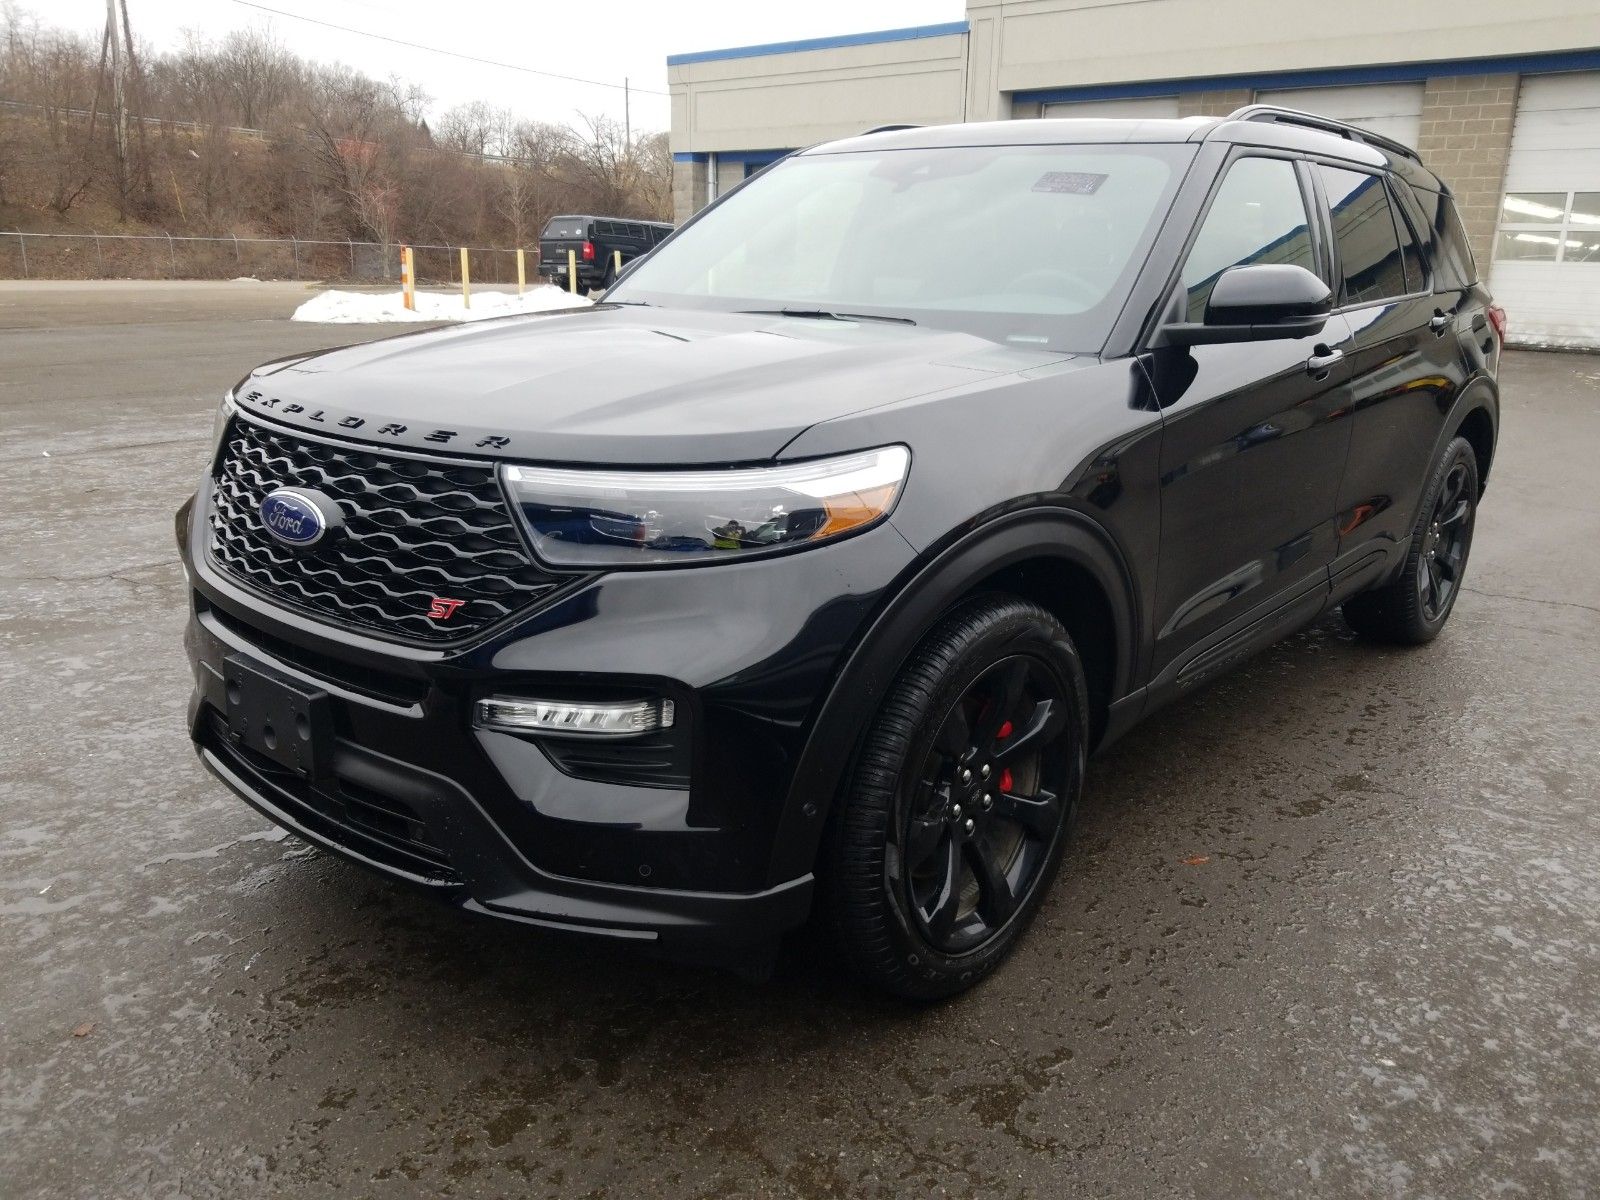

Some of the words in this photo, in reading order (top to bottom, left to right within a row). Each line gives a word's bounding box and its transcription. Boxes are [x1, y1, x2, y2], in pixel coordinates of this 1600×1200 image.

[244, 390, 512, 450] EXPLORER
[268, 500, 304, 535] Ford
[427, 597, 466, 620] ST
